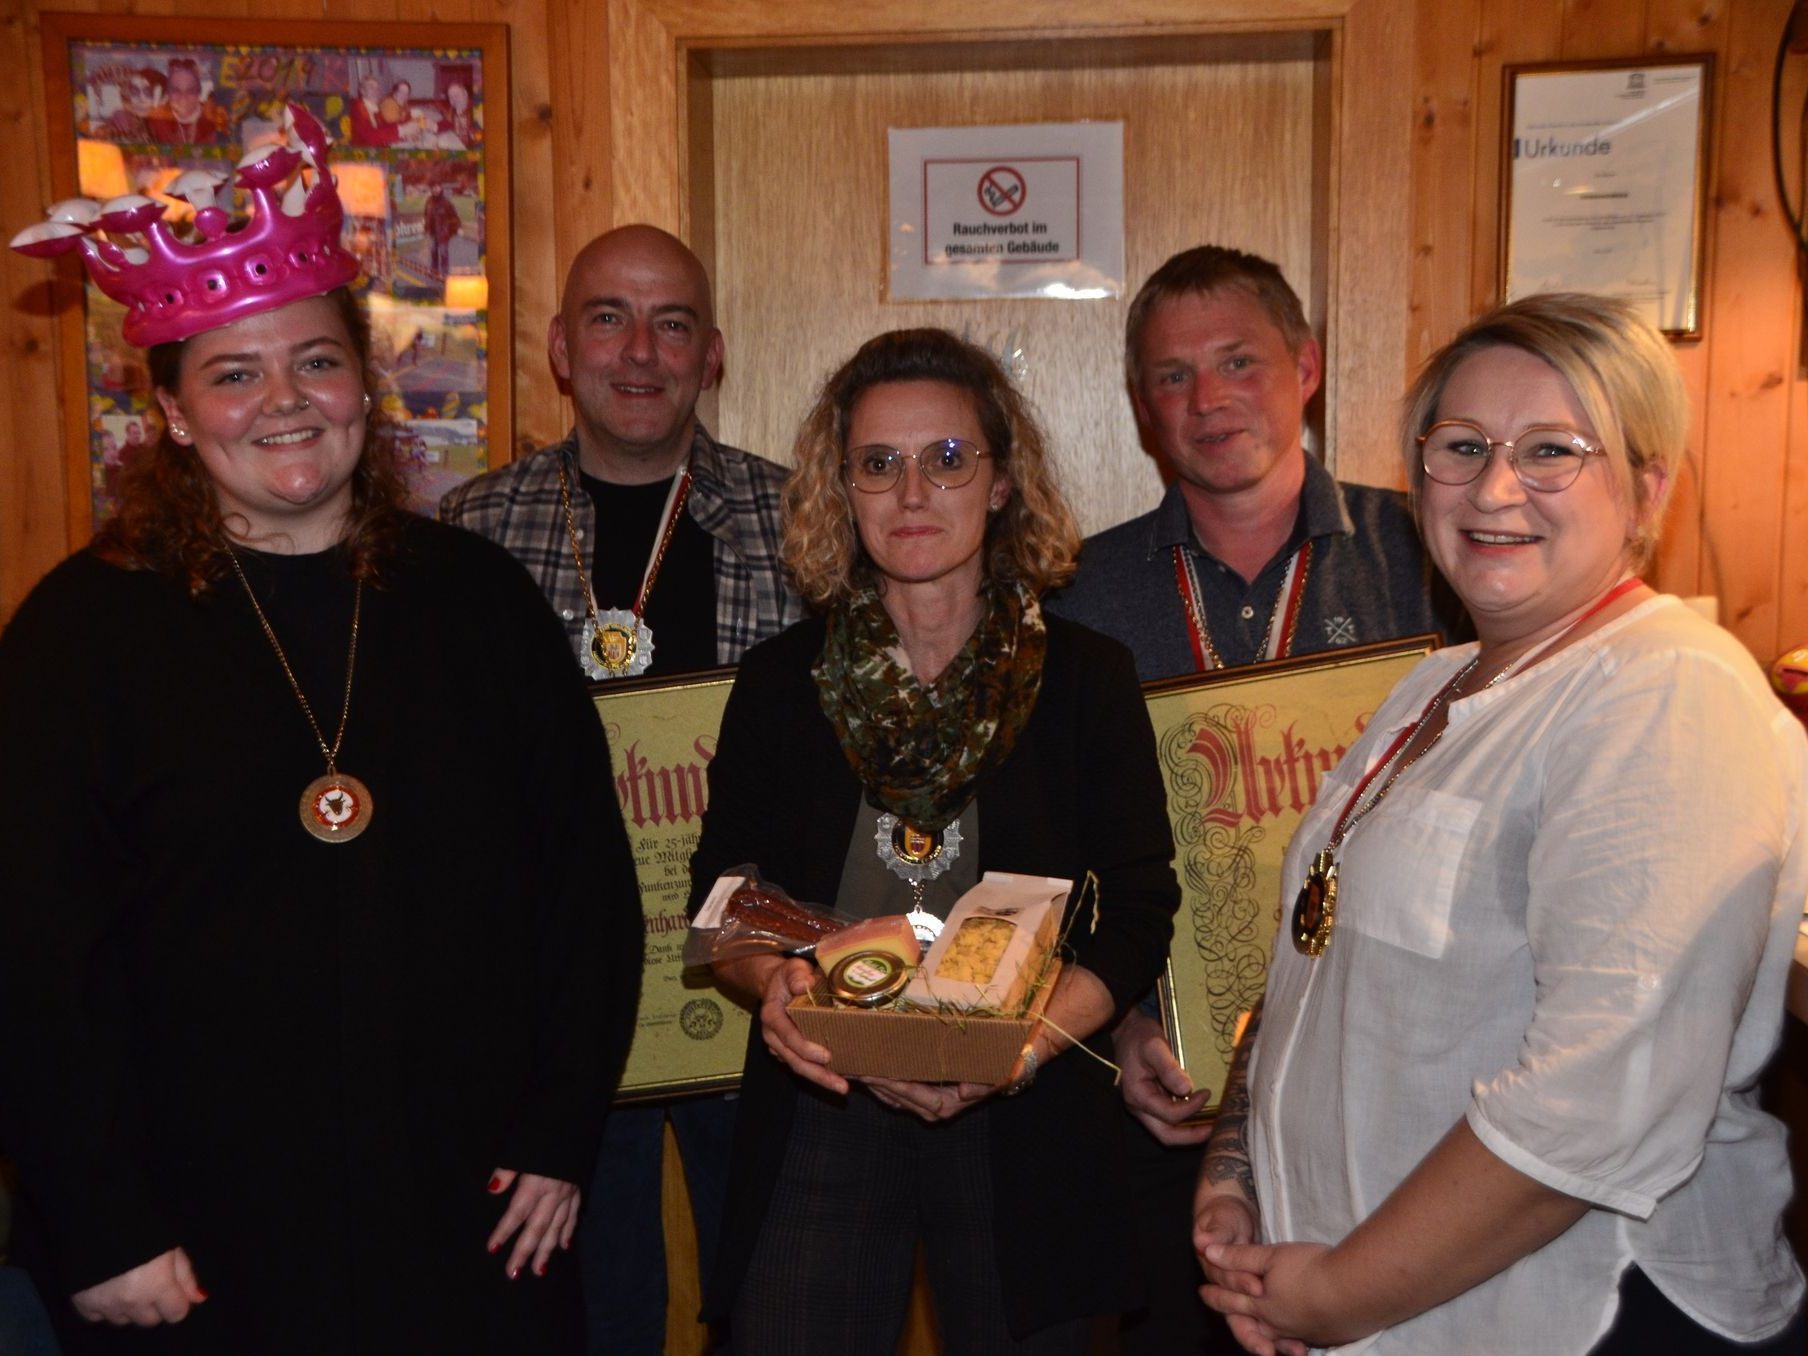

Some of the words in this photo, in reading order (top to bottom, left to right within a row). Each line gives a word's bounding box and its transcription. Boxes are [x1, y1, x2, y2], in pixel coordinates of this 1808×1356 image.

[1524, 136, 1611, 159] Urkunde
[953, 222, 1029, 236] Rauchverbot
[1032, 222, 1047, 235] im
[945, 243, 1004, 258] gesamten
[1007, 240, 1060, 254] Gebäude
[636, 837, 658, 853] Für
[664, 864, 677, 877] bei
